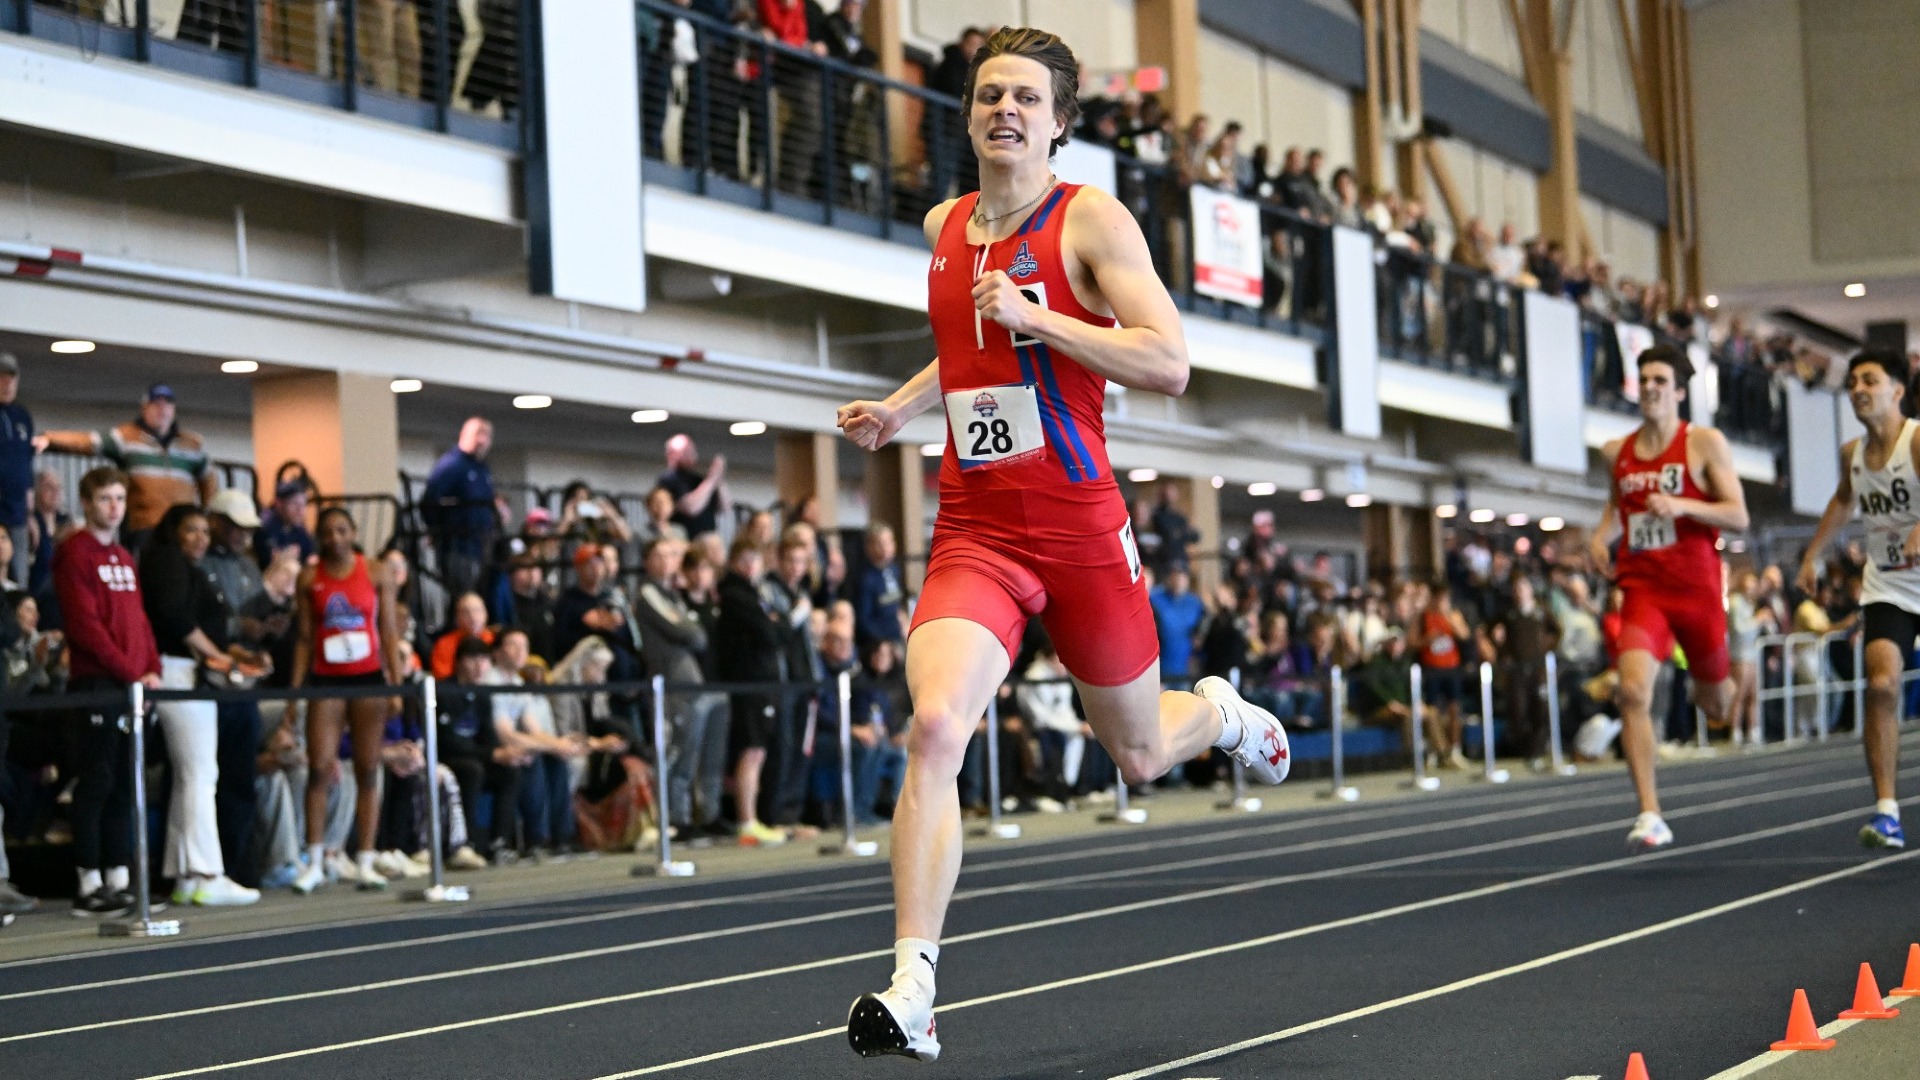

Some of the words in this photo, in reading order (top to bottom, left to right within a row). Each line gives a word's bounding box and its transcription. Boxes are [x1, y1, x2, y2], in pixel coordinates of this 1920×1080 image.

[1009, 262, 1036, 275] AMERICAN
[968, 419, 1013, 456] 28
[1619, 470, 1662, 495] BOST
[1663, 465, 1678, 491] 3
[1859, 490, 1908, 515] ARM
[1892, 478, 1910, 504] 6
[1634, 526, 1665, 545] 511
